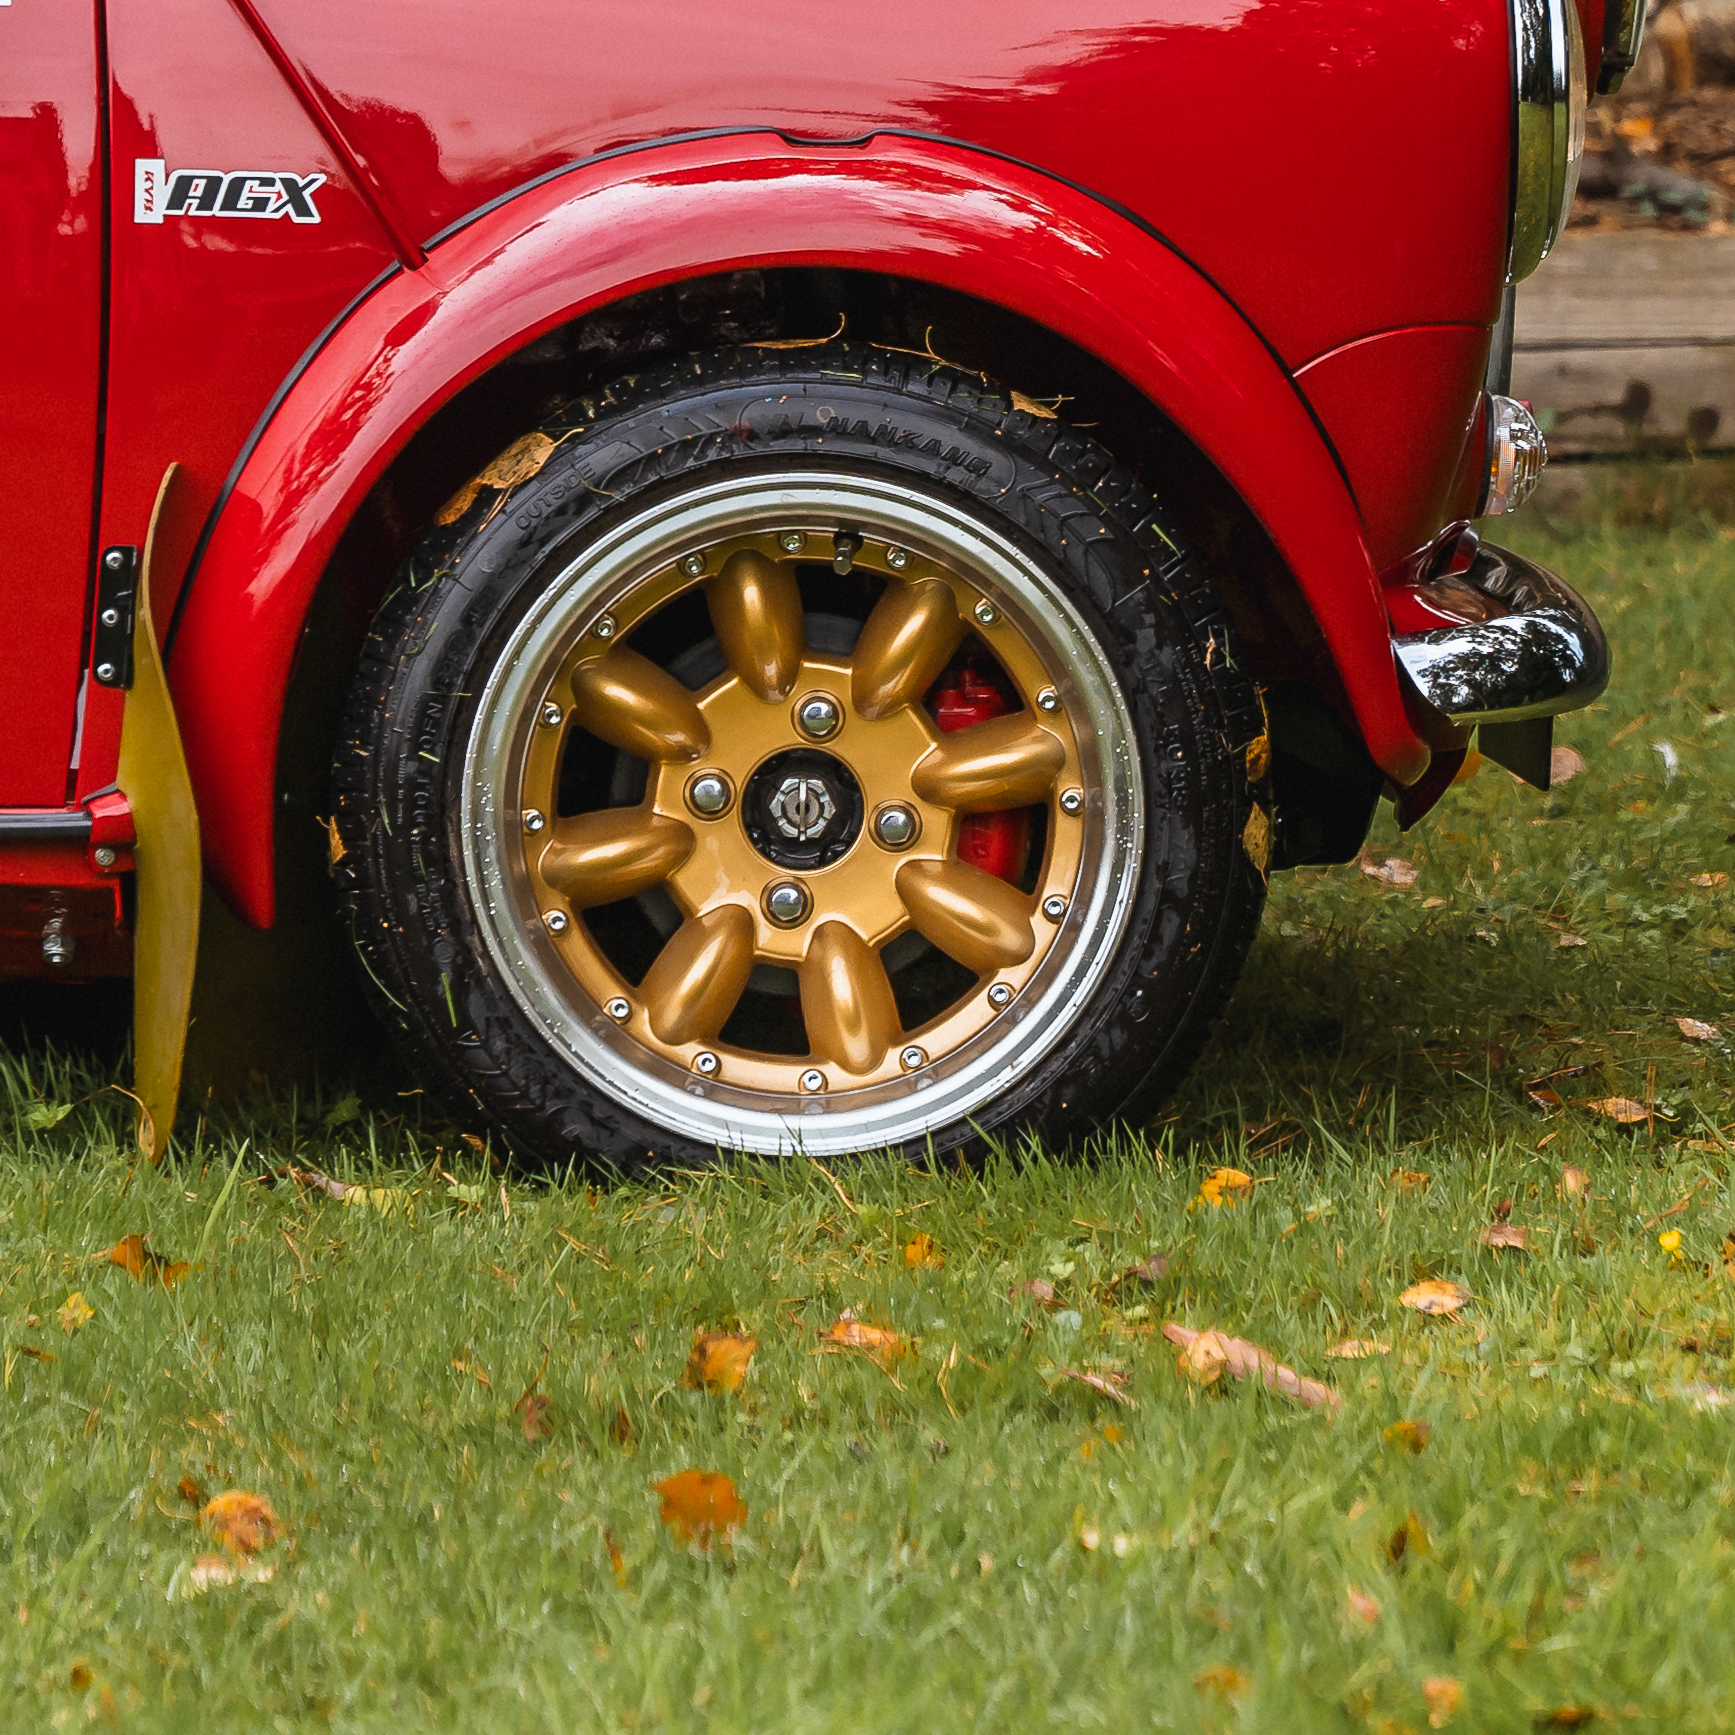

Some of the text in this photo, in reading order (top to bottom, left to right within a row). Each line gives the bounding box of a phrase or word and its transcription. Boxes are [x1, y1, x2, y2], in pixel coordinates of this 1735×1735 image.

[166, 174, 321, 219] AGX
[823, 413, 995, 478] NANKANG
[513, 460, 597, 532] OUTSIDE
